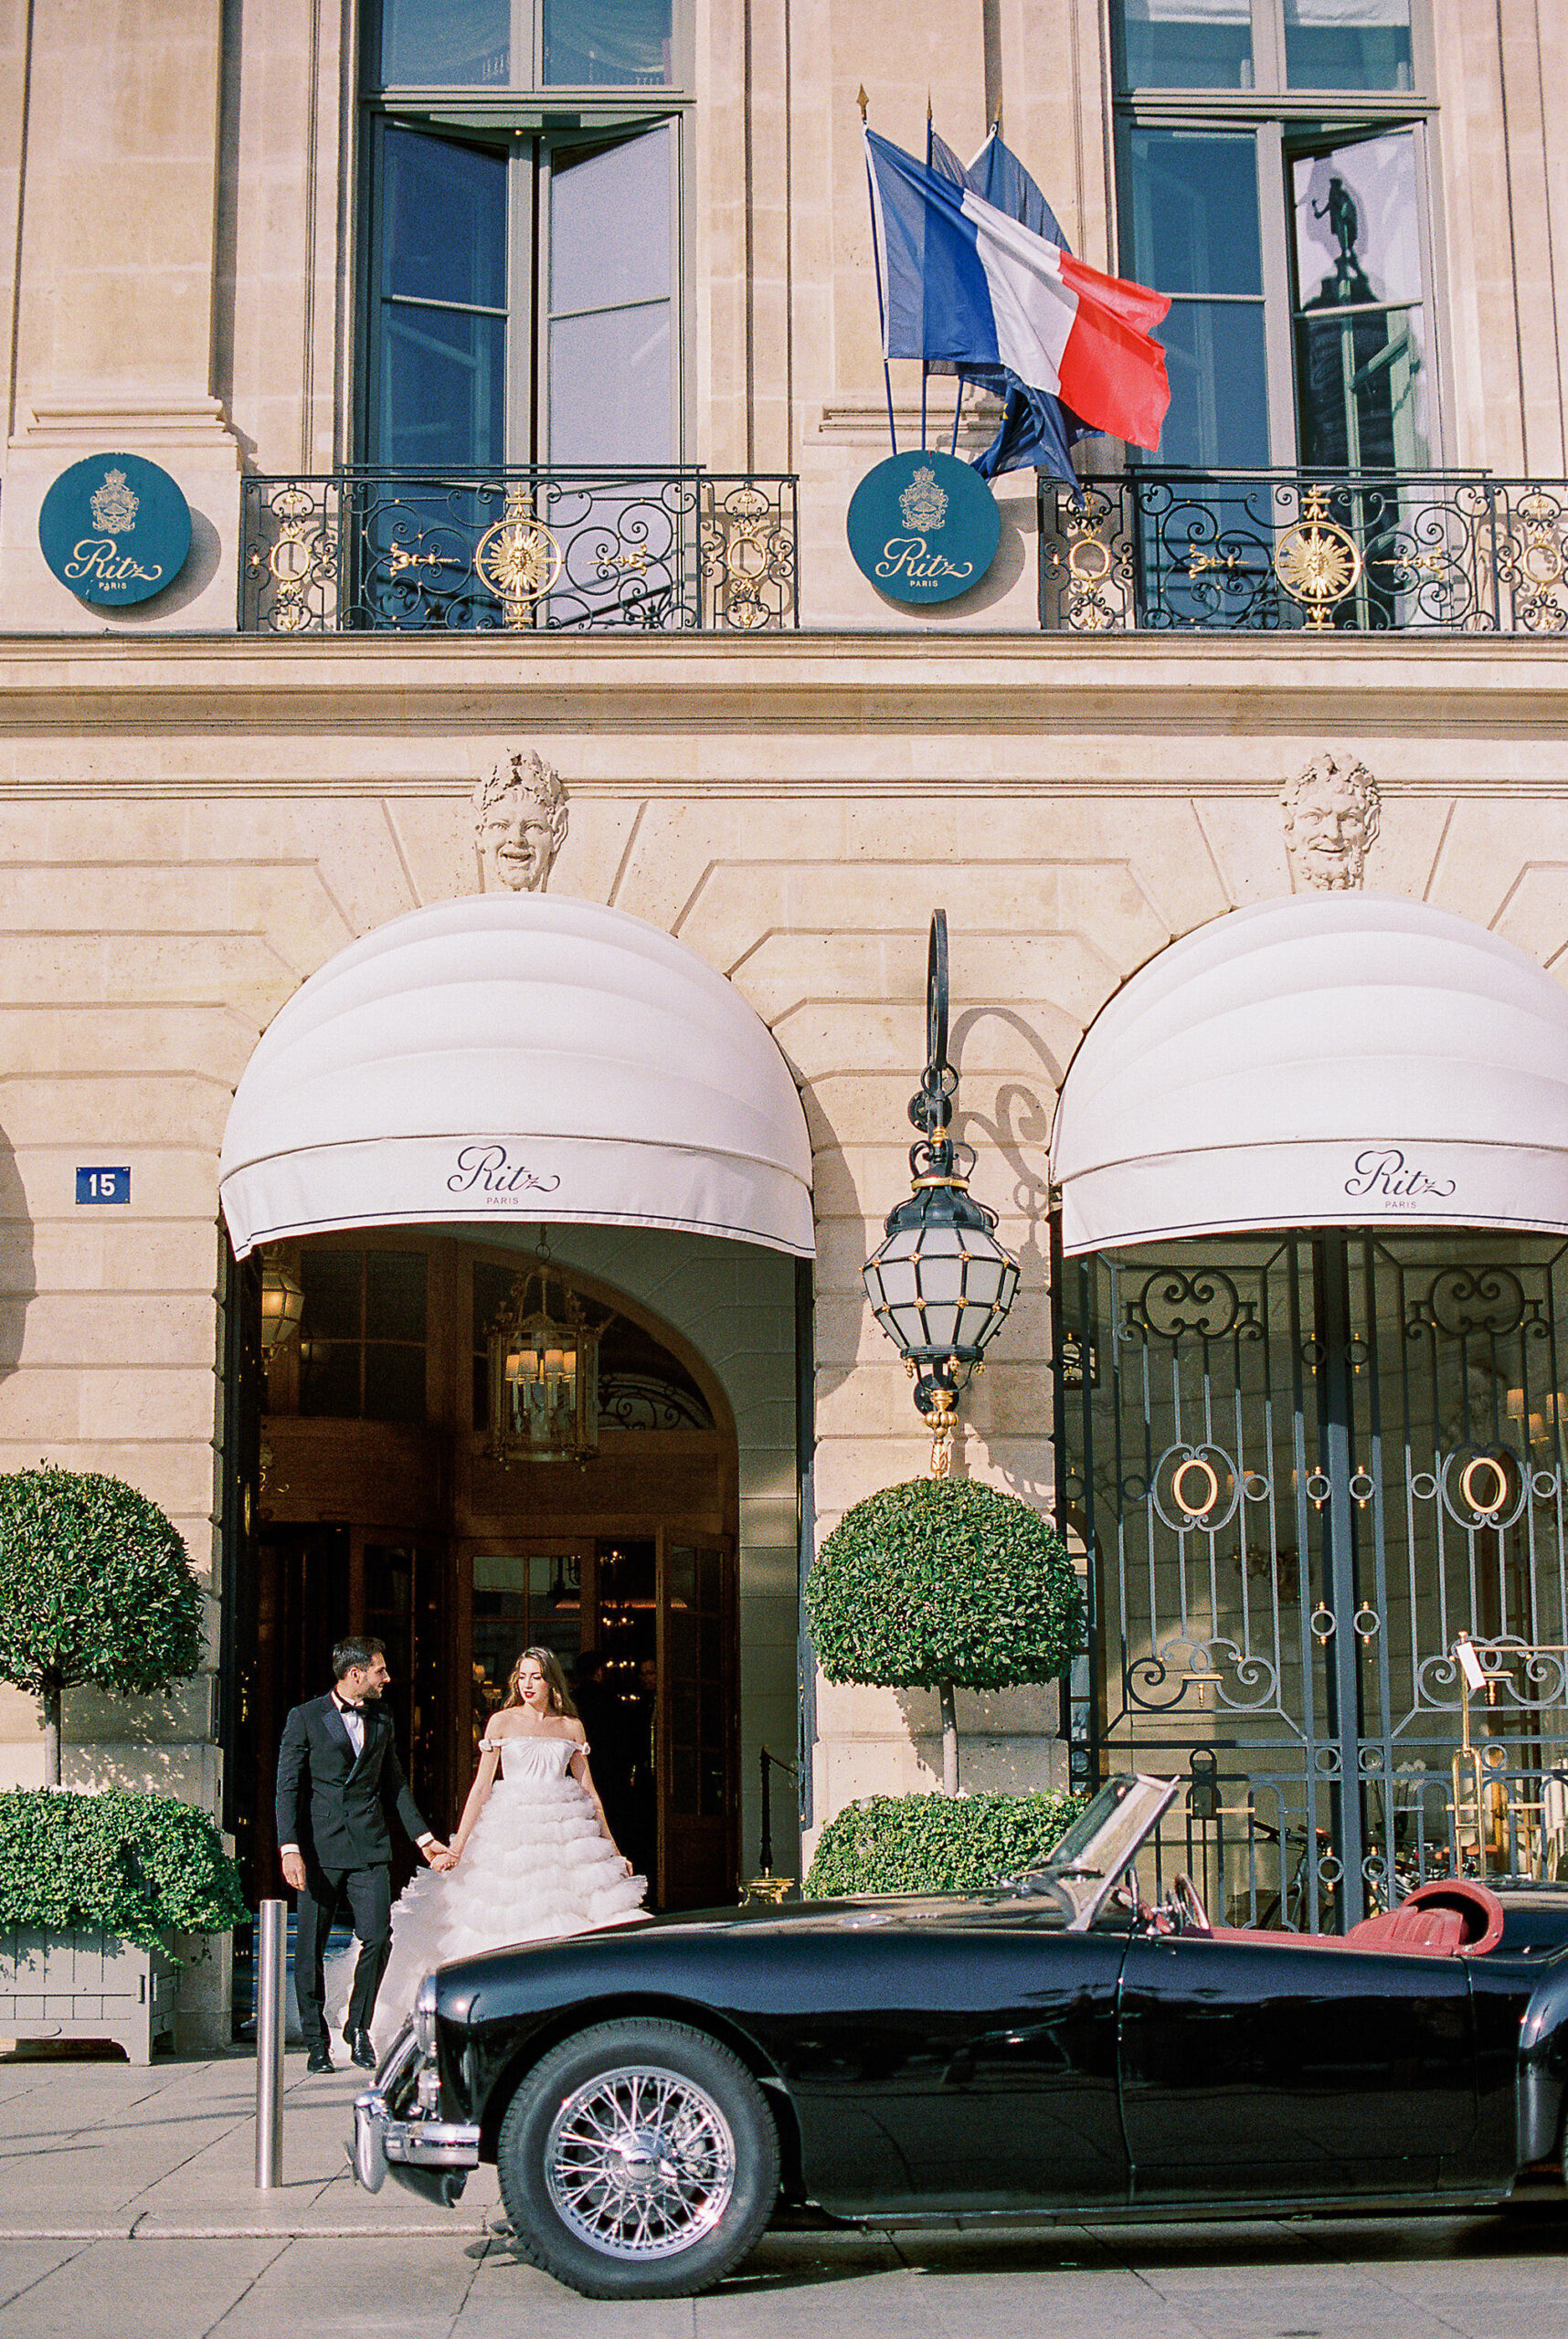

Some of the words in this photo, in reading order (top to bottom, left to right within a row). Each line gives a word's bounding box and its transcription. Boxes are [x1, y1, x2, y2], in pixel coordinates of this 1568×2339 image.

[64, 539, 163, 579] Ritz
[874, 537, 972, 577] Ritz
[89, 1174, 116, 1197] 15
[447, 1145, 561, 1192] Ritz
[1344, 1149, 1457, 1197] Ritz
[1384, 1201, 1417, 1209] PARIS
